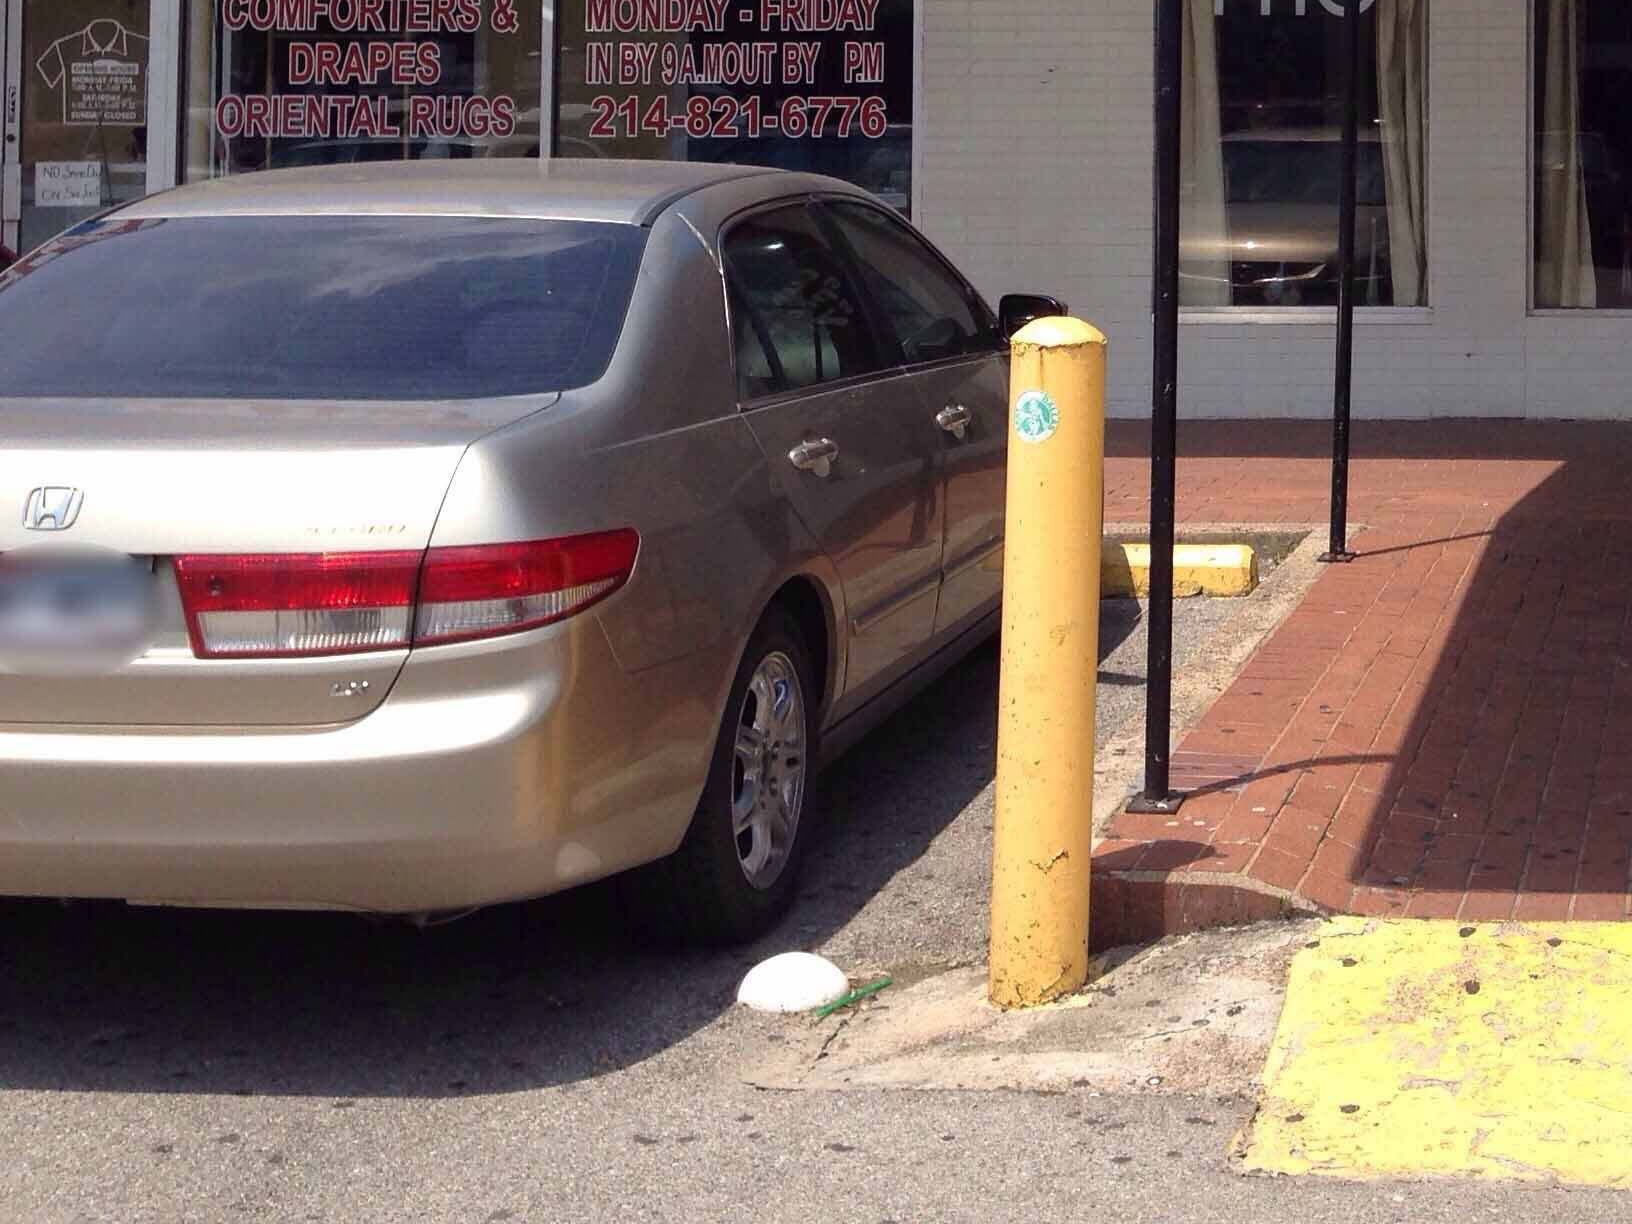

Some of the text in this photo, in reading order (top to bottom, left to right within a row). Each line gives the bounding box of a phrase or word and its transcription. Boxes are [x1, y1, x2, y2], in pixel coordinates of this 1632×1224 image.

[288, 41, 441, 86] DRAPES
[585, 42, 613, 85] IN
[618, 41, 658, 85] BY
[782, 41, 821, 85] BY
[215, 94, 515, 138] ORIENTAL RUGS
[588, 94, 888, 139] 214-821-6776
